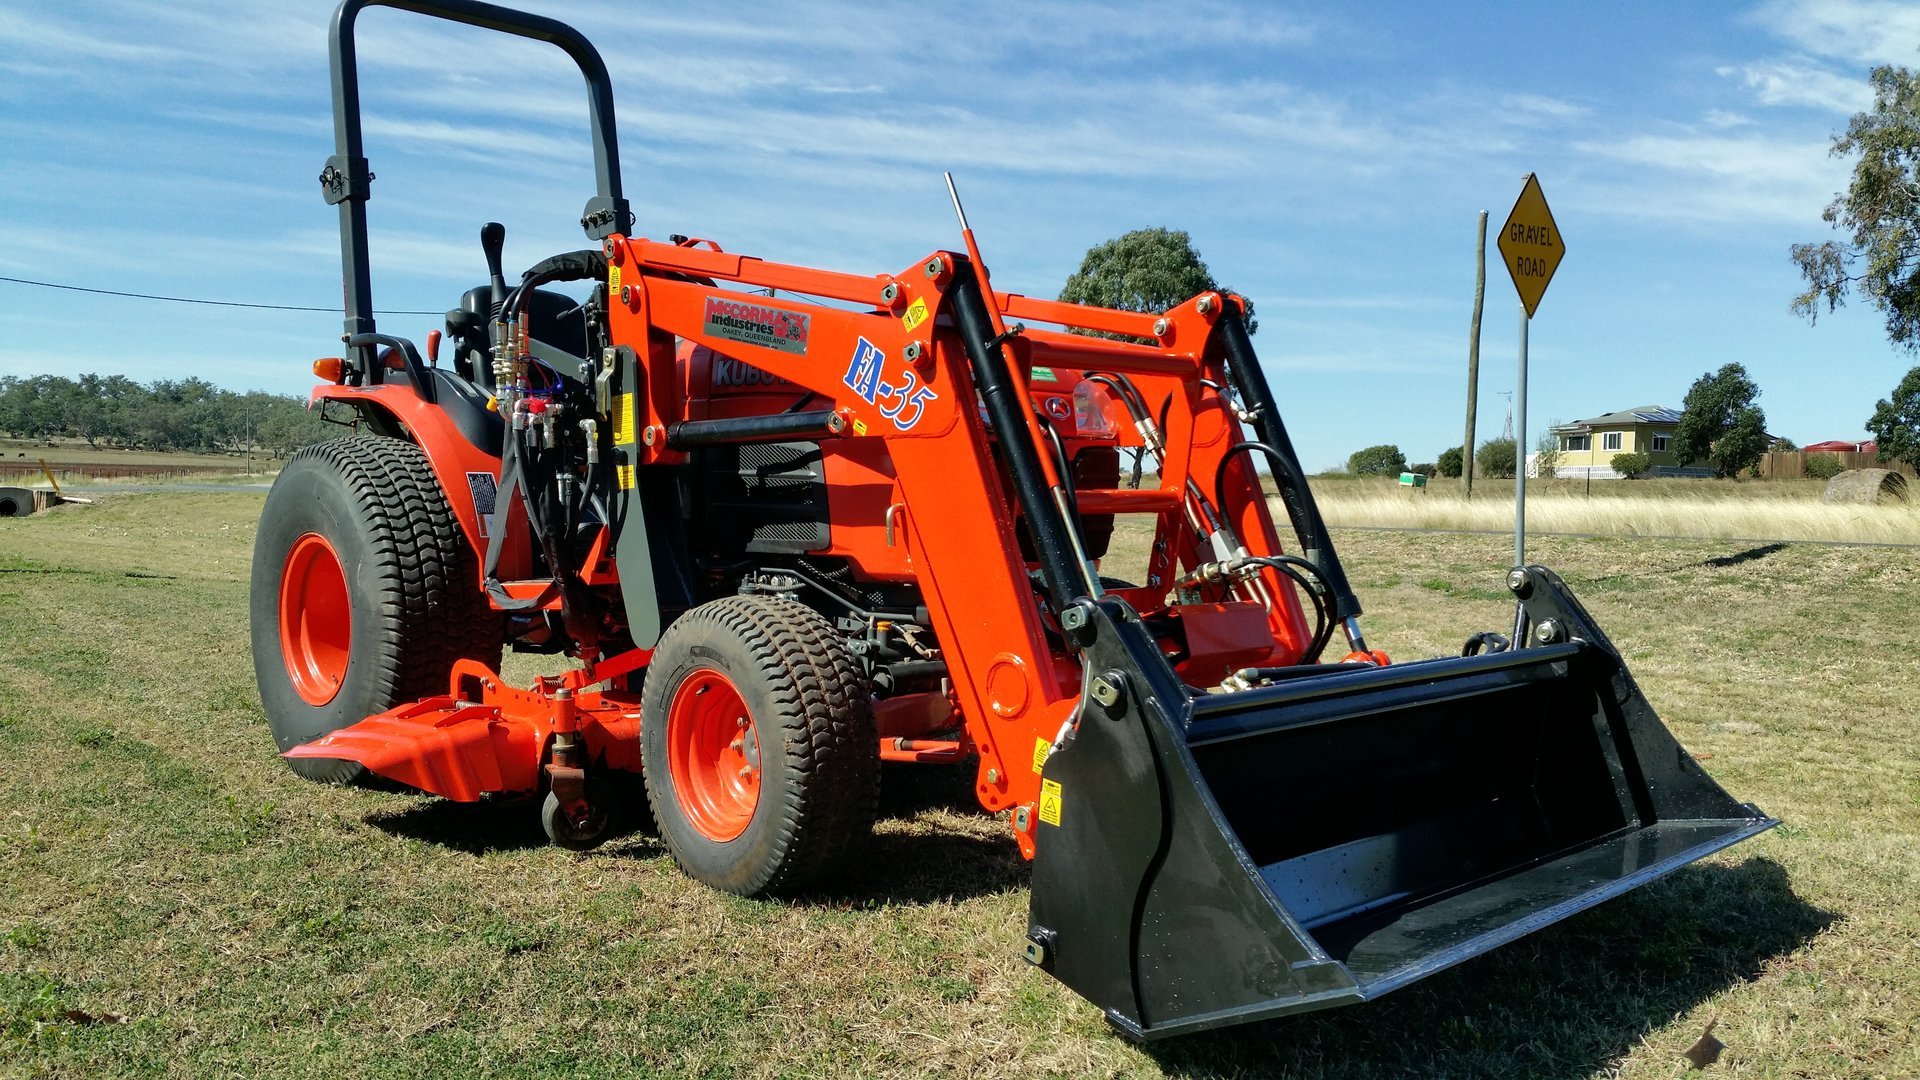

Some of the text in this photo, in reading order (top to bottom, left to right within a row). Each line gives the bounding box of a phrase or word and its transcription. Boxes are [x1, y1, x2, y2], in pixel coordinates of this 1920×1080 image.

[1510, 223, 1553, 246] GRAVEL
[1517, 256, 1546, 277] ROAD
[712, 314, 774, 335] industries
[722, 327, 743, 337] OAKEY,
[744, 331, 786, 345] QUEENSLAND
[843, 336, 938, 431] FA-35
